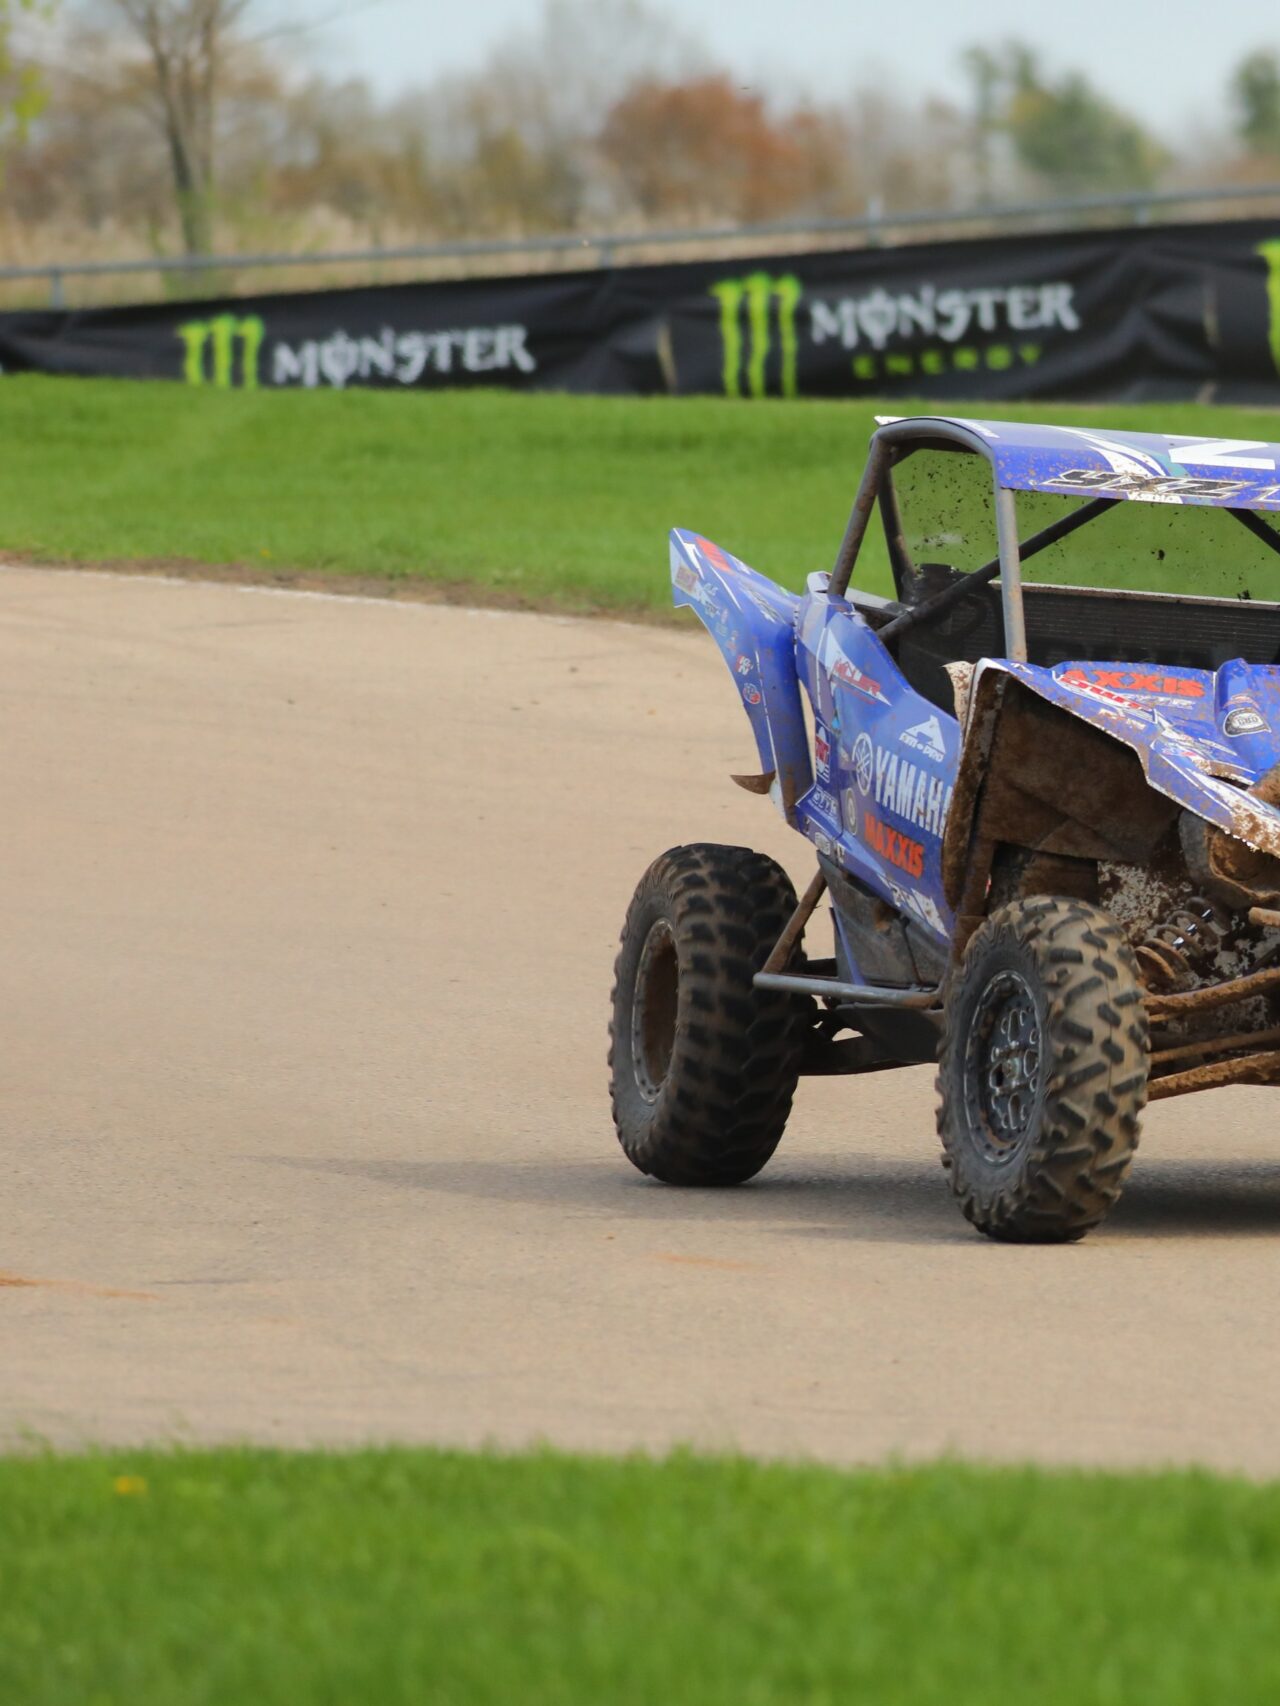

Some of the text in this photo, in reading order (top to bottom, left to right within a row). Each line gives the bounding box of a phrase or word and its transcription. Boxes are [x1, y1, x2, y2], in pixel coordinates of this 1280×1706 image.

[811, 283, 1080, 349] MONSTER
[273, 323, 536, 388] MONSTER
[1061, 669, 1206, 697] AXXIS
[863, 811, 925, 880] MAXXIS
